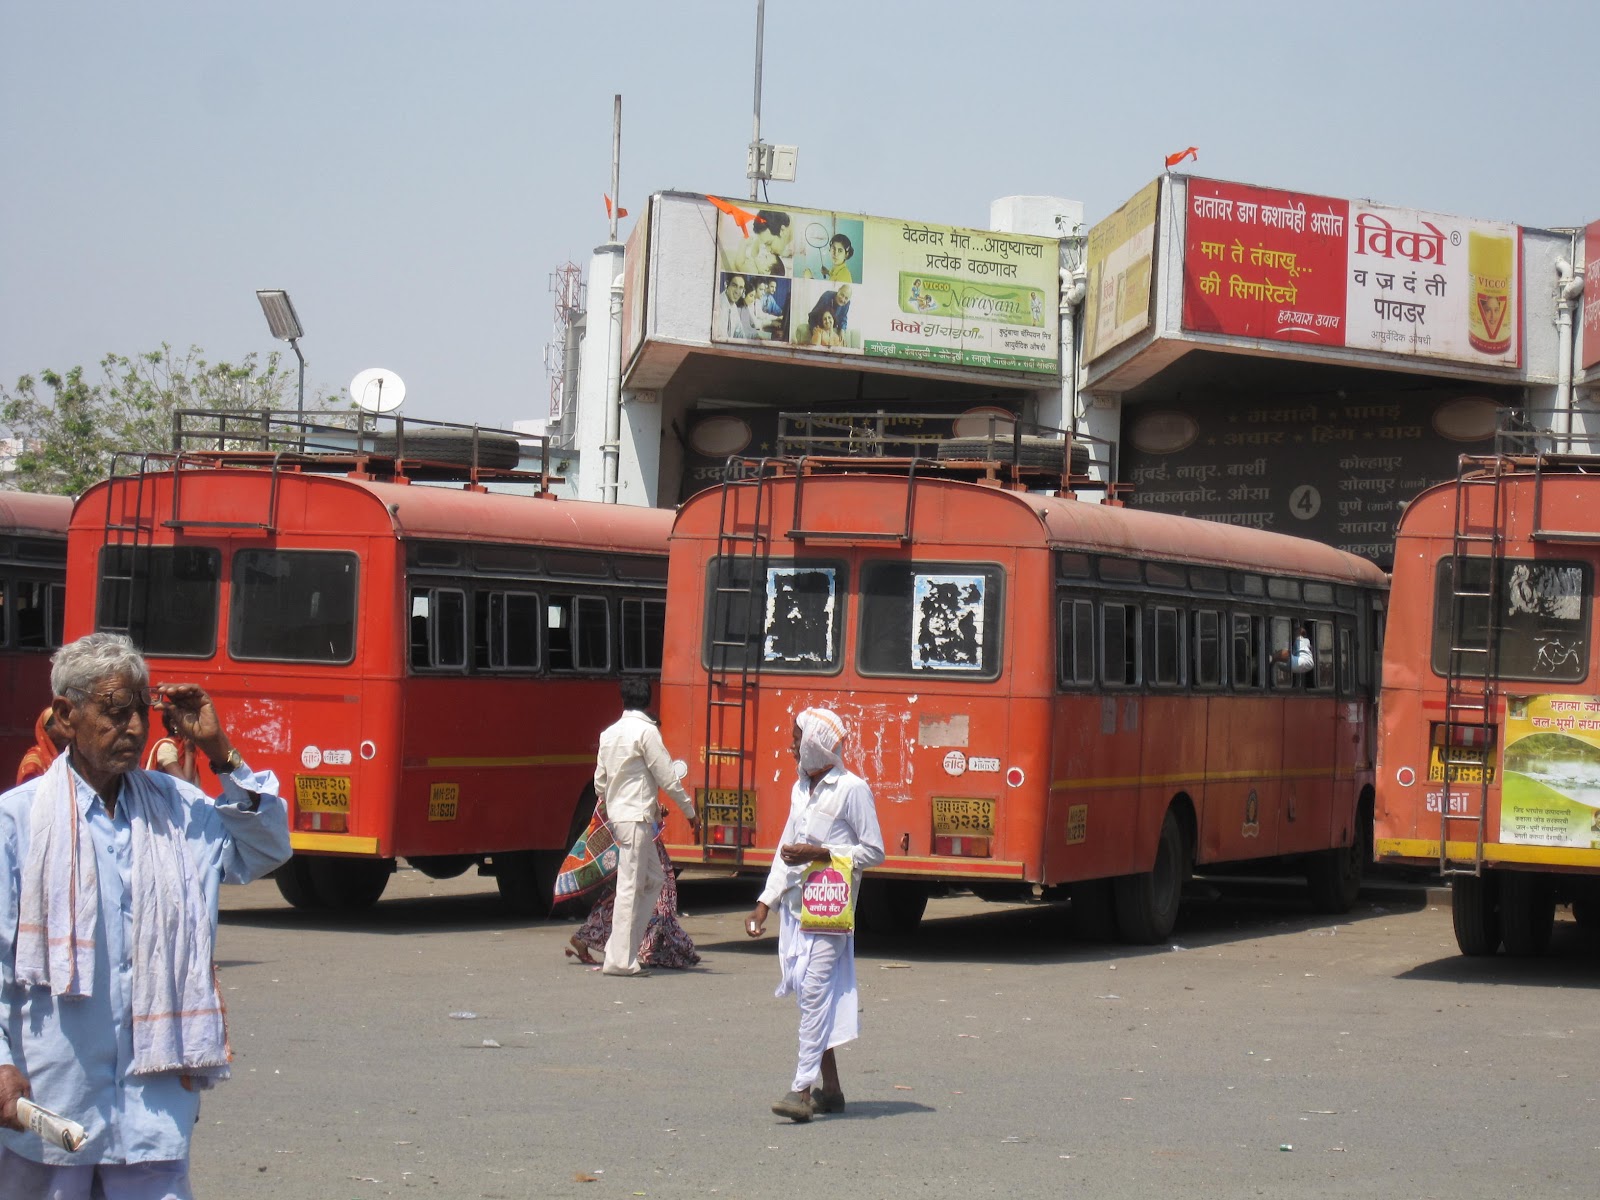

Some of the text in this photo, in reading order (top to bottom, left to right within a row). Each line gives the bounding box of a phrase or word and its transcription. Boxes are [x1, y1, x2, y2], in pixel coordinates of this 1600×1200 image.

[1193, 190, 1344, 237] दातांवर डाग कशाचेही असोत
[902, 223, 944, 246] वेदनेवर
[1354, 213, 1447, 266] विको
[1200, 241, 1225, 261] मग
[1230, 238, 1245, 264] ते
[925, 252, 1018, 279] प्रत्येक वळणावर
[923, 281, 950, 292] VICCO
[1199, 271, 1298, 306] की सिगारेटचे
[1478, 276, 1506, 289] VICCO
[1373, 298, 1426, 325] पावडर
[891, 318, 921, 334] विको
[1298, 490, 1312, 513] 4
[1338, 521, 1388, 534] सातारा
[950, 815, 991, 830] १२३३
